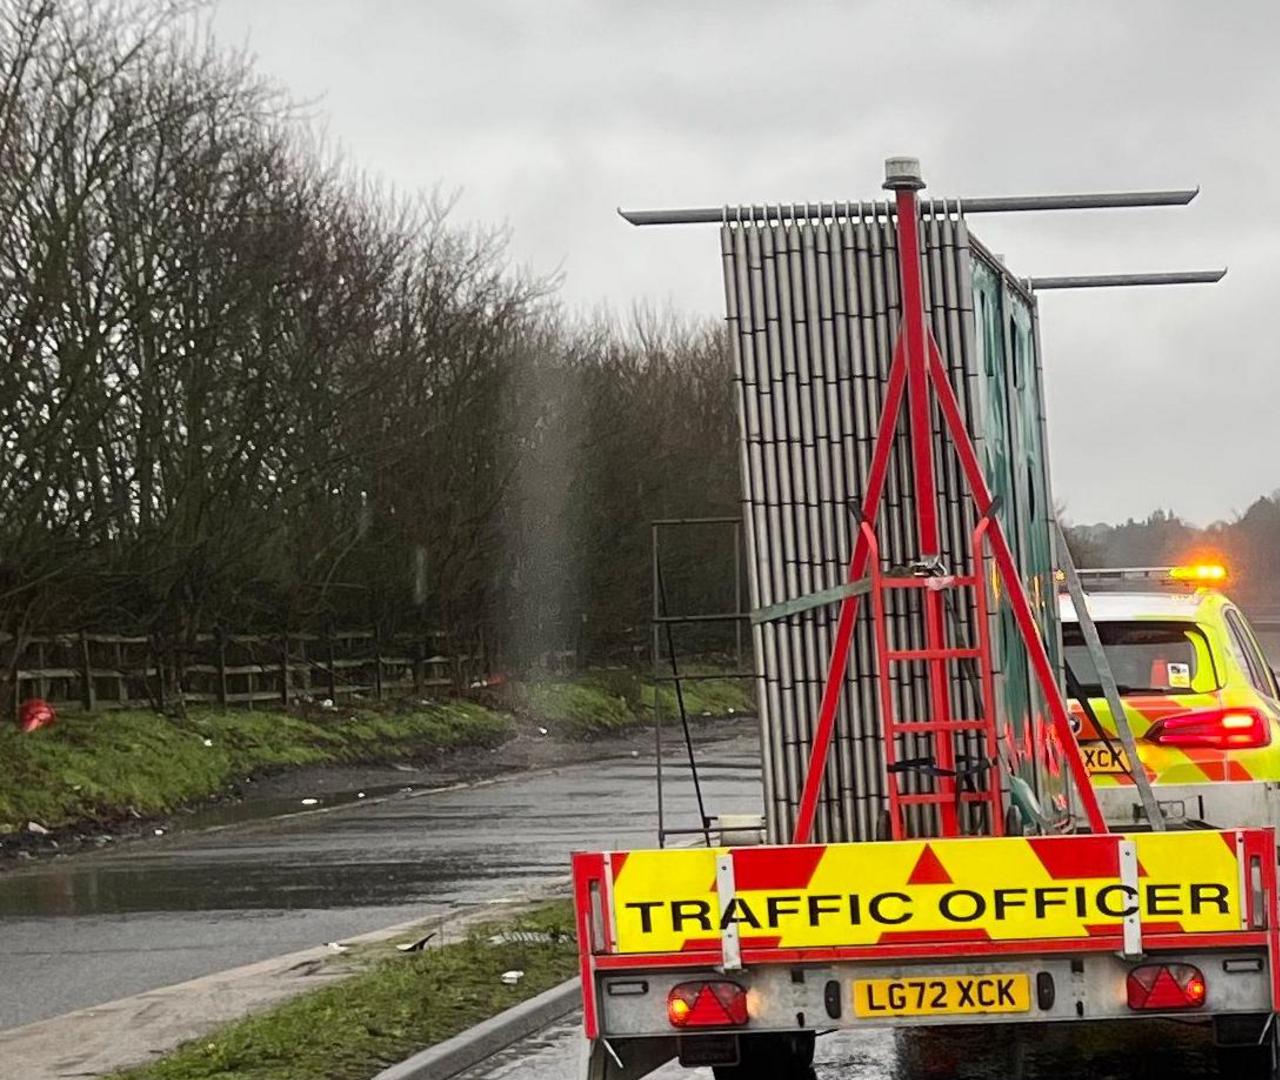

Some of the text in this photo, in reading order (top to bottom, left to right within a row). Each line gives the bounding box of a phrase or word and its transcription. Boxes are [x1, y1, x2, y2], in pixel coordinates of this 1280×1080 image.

[625, 883, 1231, 933] TRAFFIC OFFICER
[867, 978, 1016, 1011] LG72 XCK
